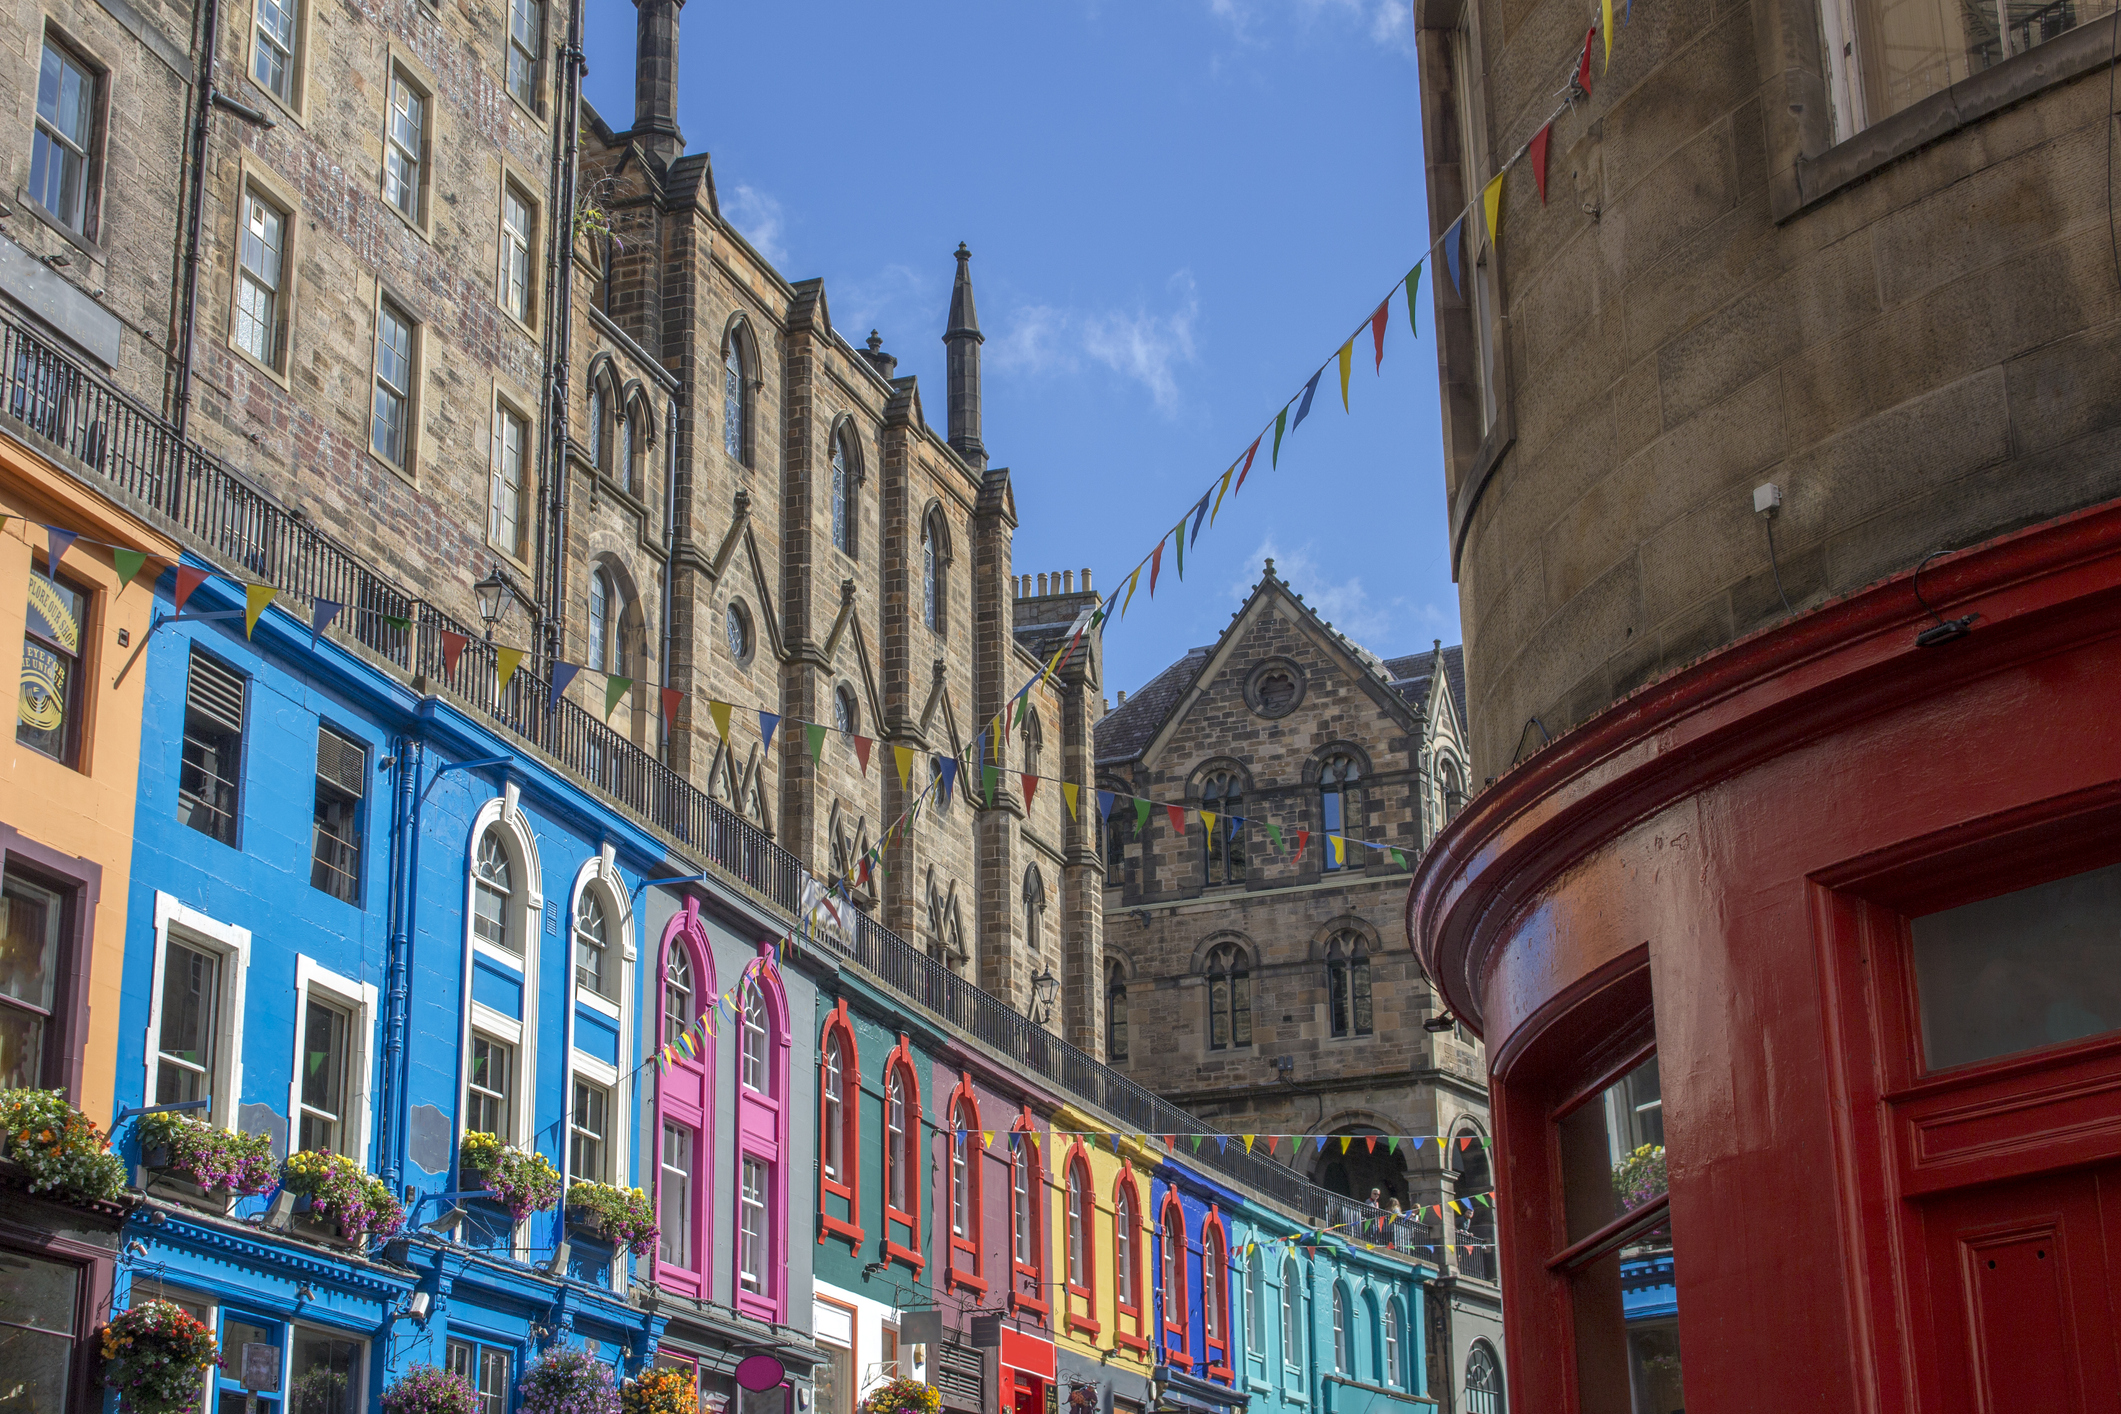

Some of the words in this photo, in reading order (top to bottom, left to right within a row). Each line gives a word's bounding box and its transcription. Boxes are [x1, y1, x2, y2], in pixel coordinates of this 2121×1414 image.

[0, 270, 38, 303] URDISH
[47, 600, 62, 625] OUR
[59, 620, 75, 647] SHOP
[27, 646, 46, 661] EYE
[47, 655, 65, 680] FOR
[32, 658, 64, 689] UNIQUE
